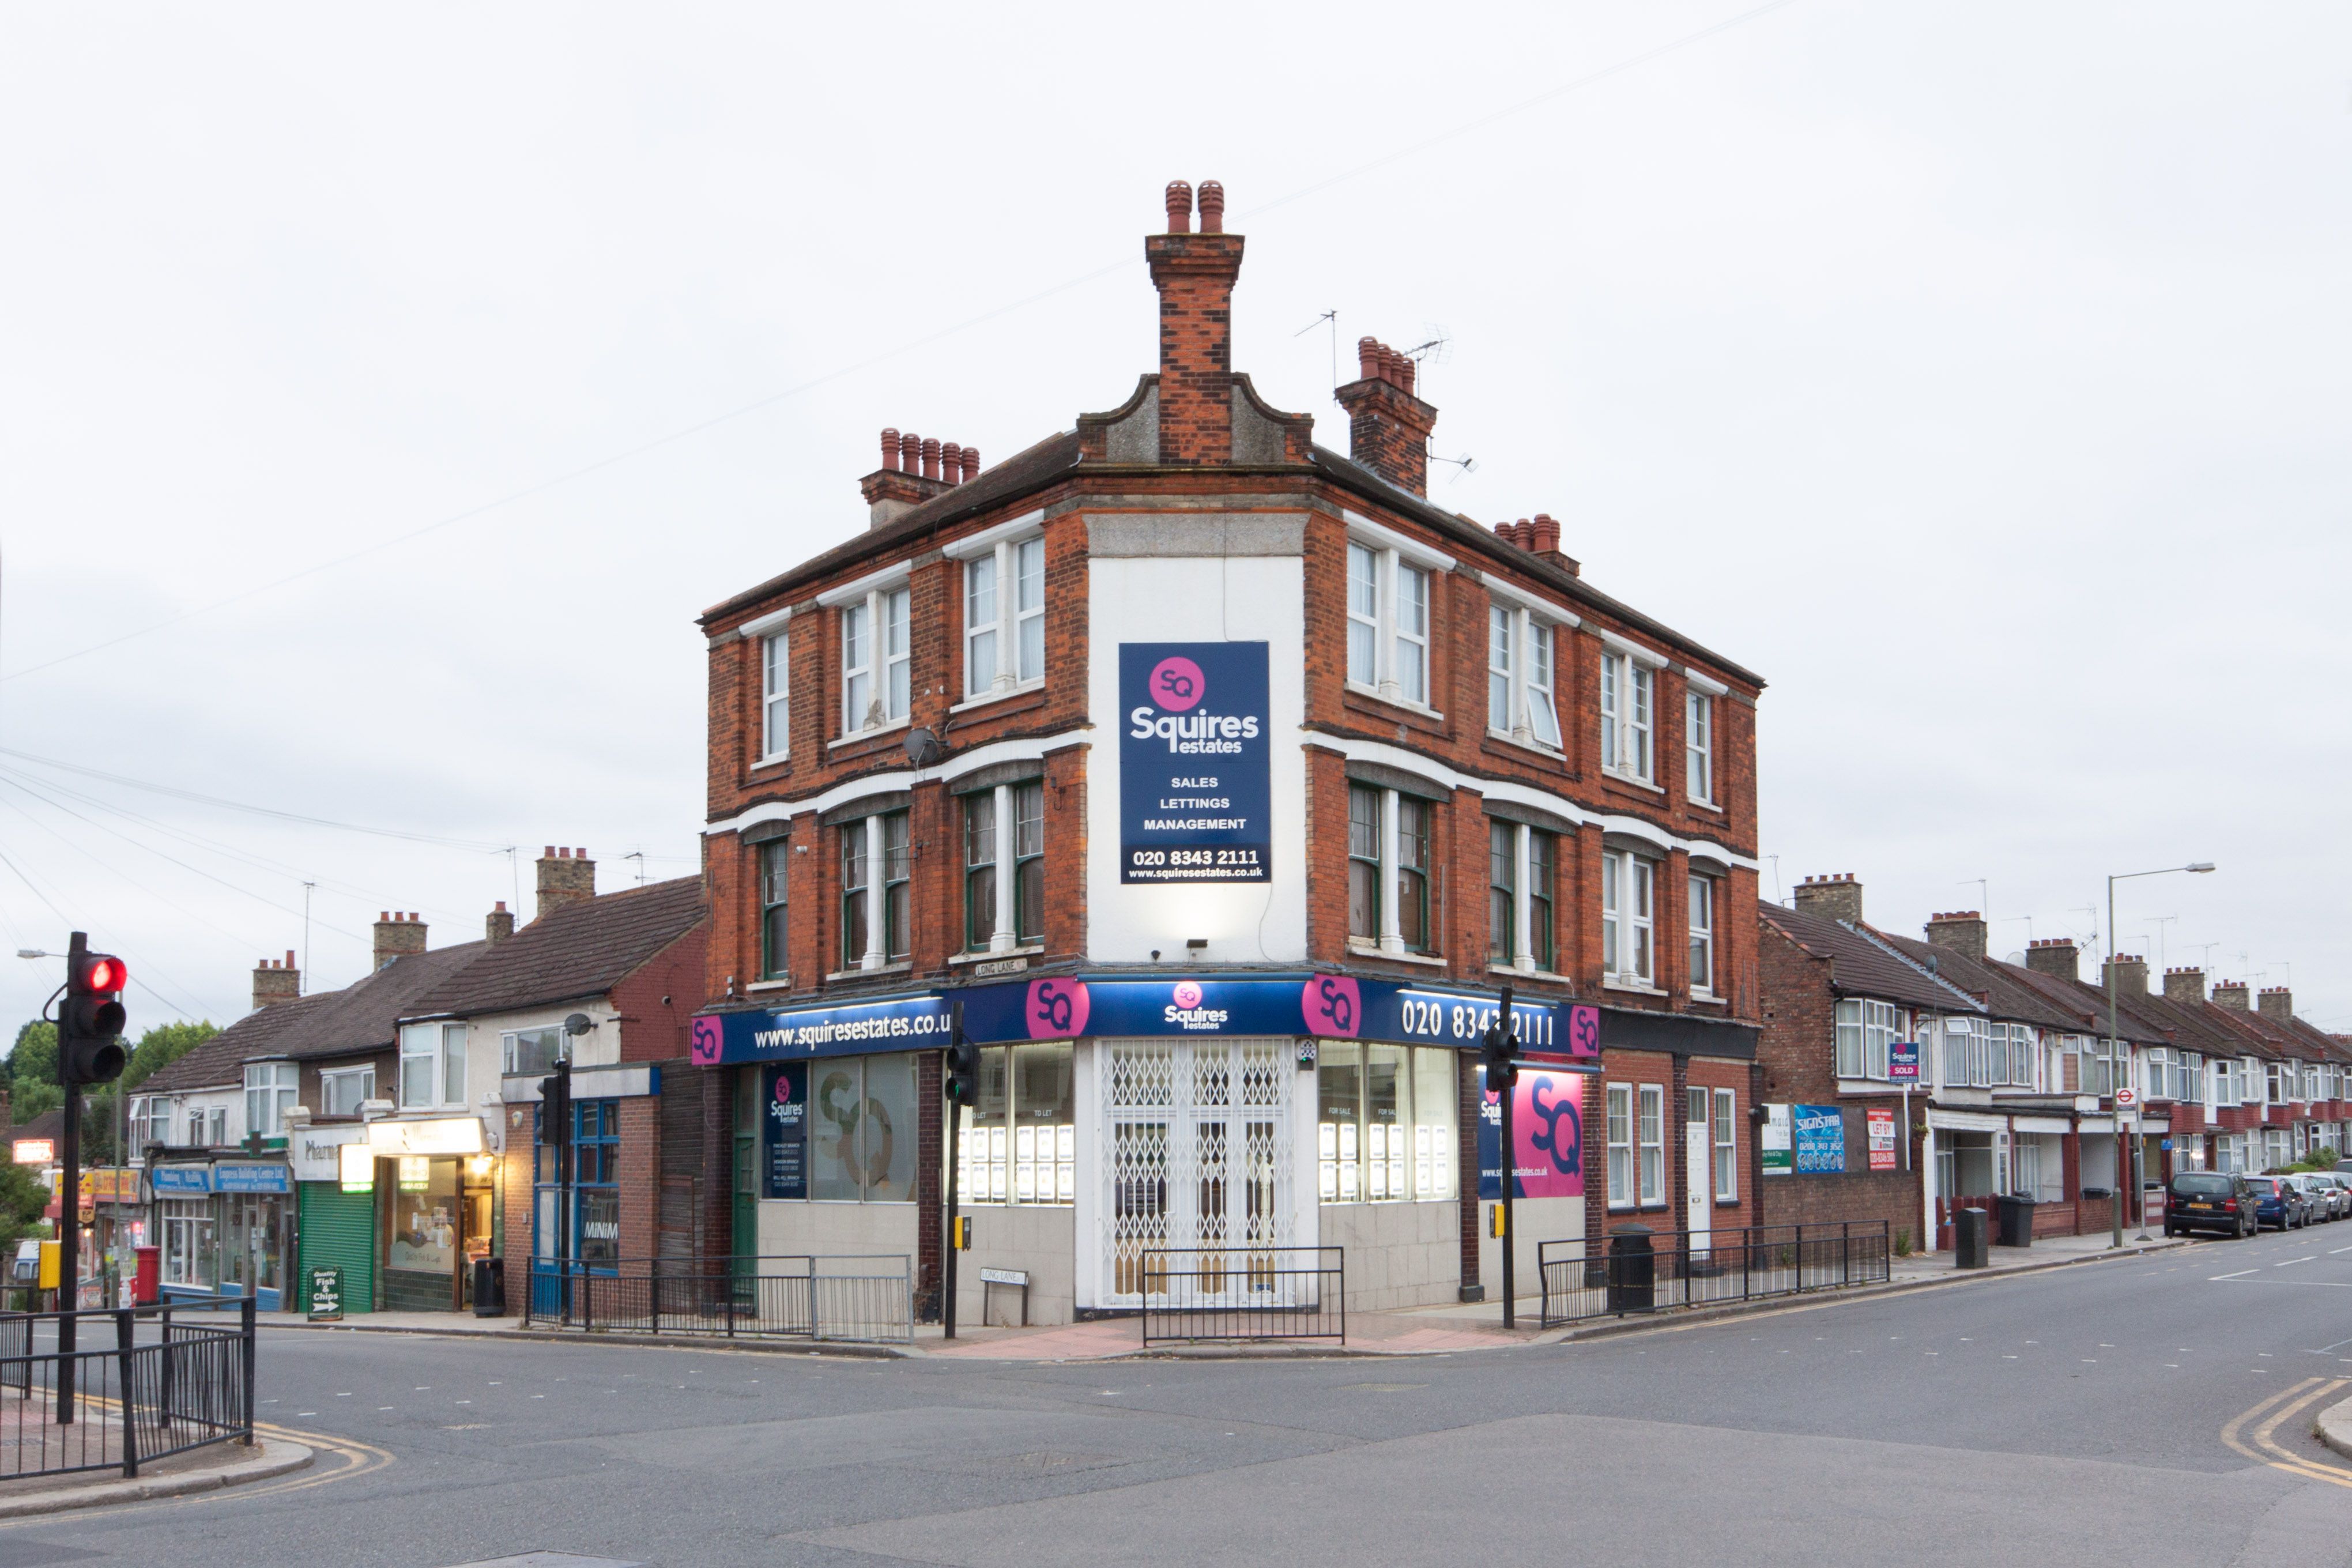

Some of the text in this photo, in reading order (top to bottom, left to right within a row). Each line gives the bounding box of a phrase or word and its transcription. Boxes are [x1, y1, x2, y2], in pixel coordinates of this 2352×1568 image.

[1160, 669, 1194, 698] SQ
[1130, 707, 1259, 753] Squires
[1179, 739, 1242, 754] estates
[1171, 777, 1219, 788] SALES
[1160, 798, 1230, 809] LETTINGS
[1144, 819, 1246, 830] MANAGEMENT
[1133, 850, 1259, 865] 020 8343 2111
[1129, 866, 1263, 880] www.squiresestates.co.uk
[978, 964, 995, 975] LONG
[997, 961, 1015, 973] LANE
[1180, 987, 1196, 1001] SQ
[1038, 982, 1072, 1031] SQ
[1321, 979, 1351, 1031] SQ
[1164, 1005, 1228, 1030] Squires
[1402, 1000, 1442, 1036] 020
[1511, 1011, 1552, 1046] 2111
[755, 1014, 951, 1051] www.squiresestates.co.u
[1188, 1021, 1220, 1030] estates
[1577, 1009, 1597, 1051] SQ
[693, 1020, 715, 1060] SQ
[1893, 1053, 1916, 1062] Squires
[771, 1100, 803, 1124] Squires
[1481, 1100, 1502, 1125] Squi
[1531, 1076, 1581, 1178] SQ
[1873, 1123, 1891, 1135] LET BY
[316, 1277, 336, 1286] Fish
[982, 1270, 998, 1280] LONG
[1001, 1272, 1016, 1281] LANE
[313, 1292, 338, 1301] Chips
